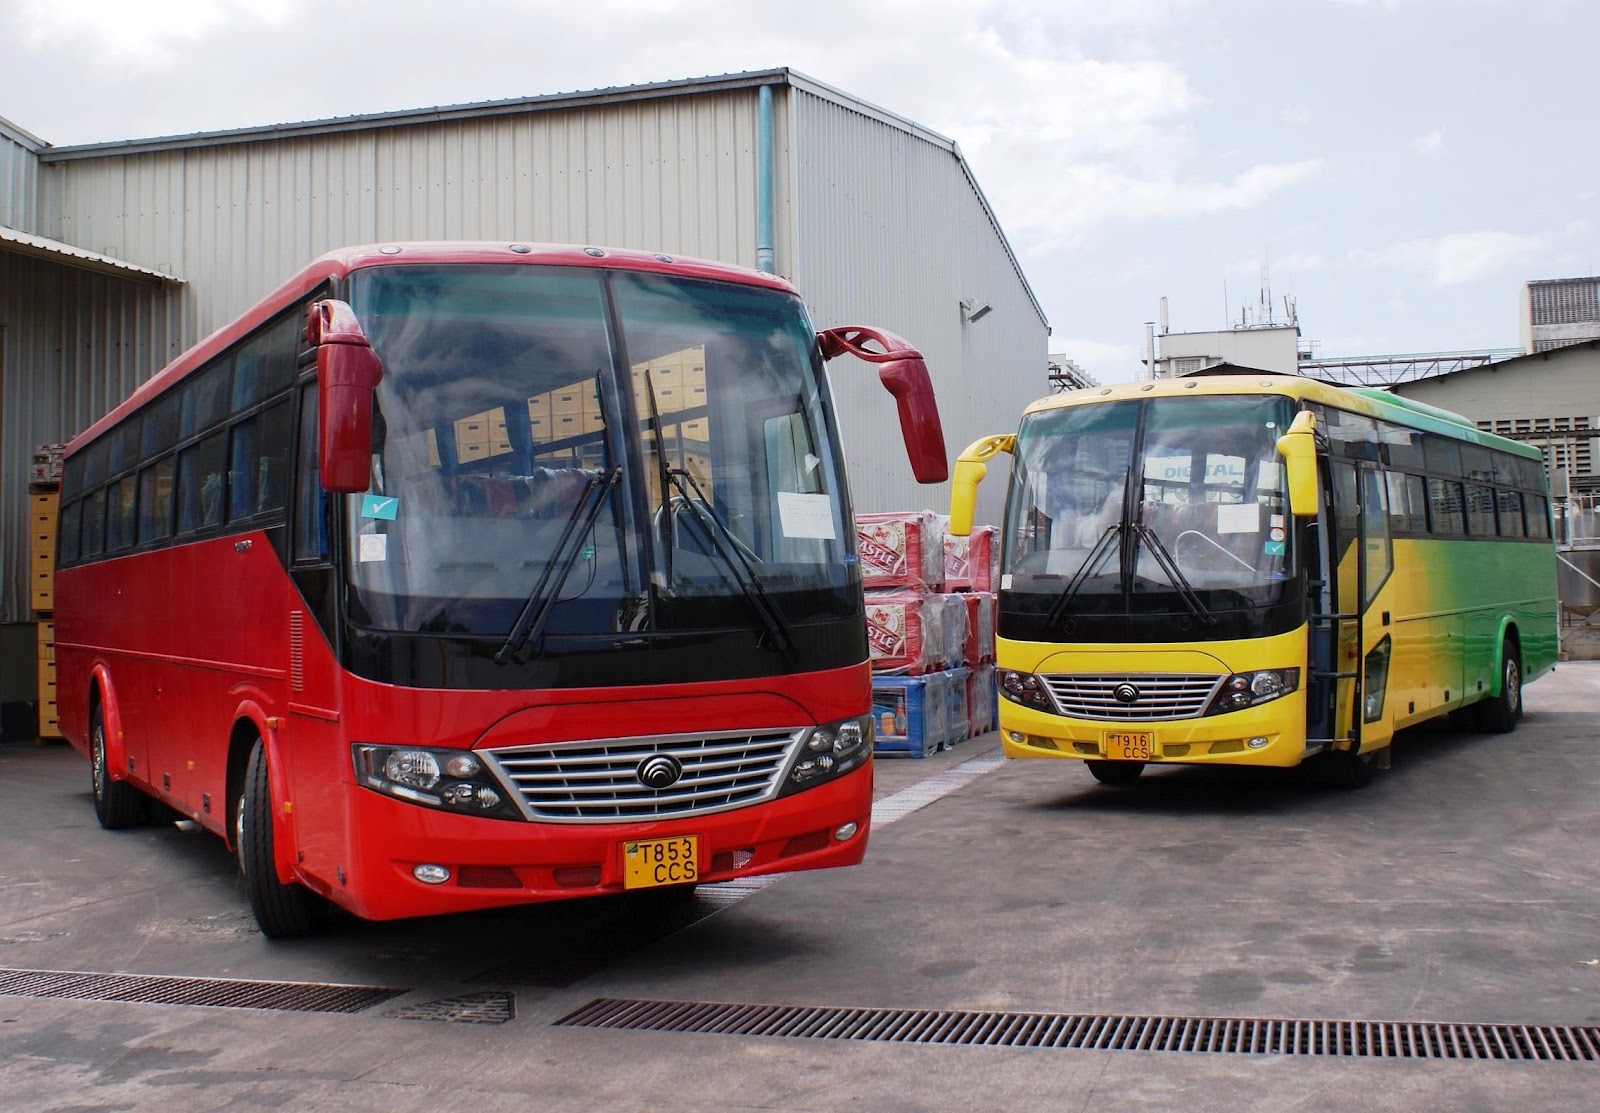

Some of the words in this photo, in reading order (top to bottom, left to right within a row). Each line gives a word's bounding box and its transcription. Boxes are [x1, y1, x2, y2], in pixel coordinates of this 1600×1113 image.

[1164, 464, 1243, 478] DIGTAL
[859, 540, 895, 567] ASTLE
[867, 626, 895, 649] STLE
[1114, 734, 1147, 747] T916
[1123, 747, 1149, 759] CCS
[639, 839, 692, 864] T853
[654, 860, 695, 883] CCS
